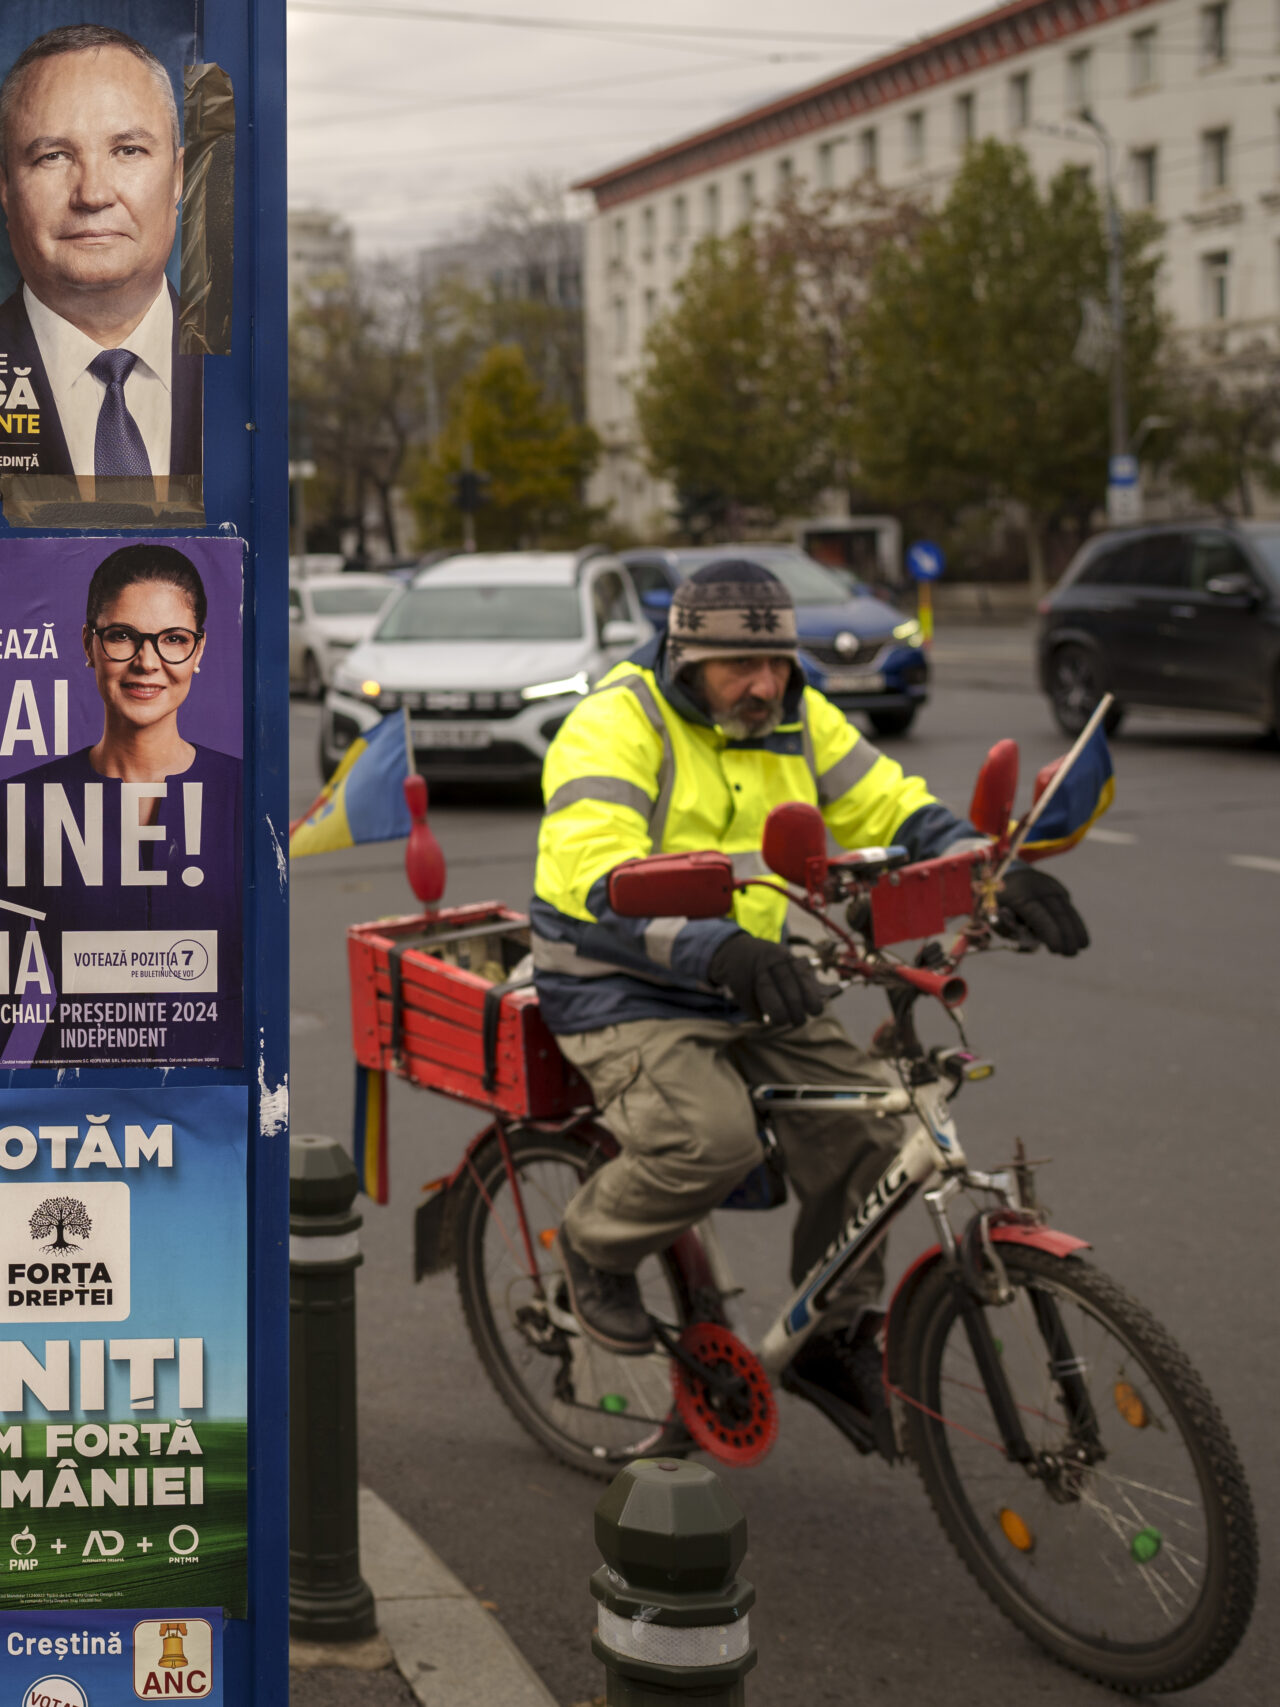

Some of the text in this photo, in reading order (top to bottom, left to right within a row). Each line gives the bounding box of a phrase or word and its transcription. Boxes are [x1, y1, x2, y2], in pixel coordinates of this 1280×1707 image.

[73, 948, 194, 971] VOTEAZĂ POZIȚIA 7
[140, 970, 172, 978] BULETINUL
[60, 1002, 166, 1027] PREȘEDINTE
[172, 1002, 218, 1022] 2024
[60, 1027, 167, 1048] INDEPENDENT
[8, 1262, 112, 1288] FORȚA
[8, 1287, 113, 1306] DREPTEI
[46, 1419, 203, 1457] FORȚĂ
[9, 1559, 38, 1571] PMP
[6, 1632, 122, 1661] Creștină
[142, 1670, 207, 1696] ANC
[31, 1691, 80, 1707] VOT
